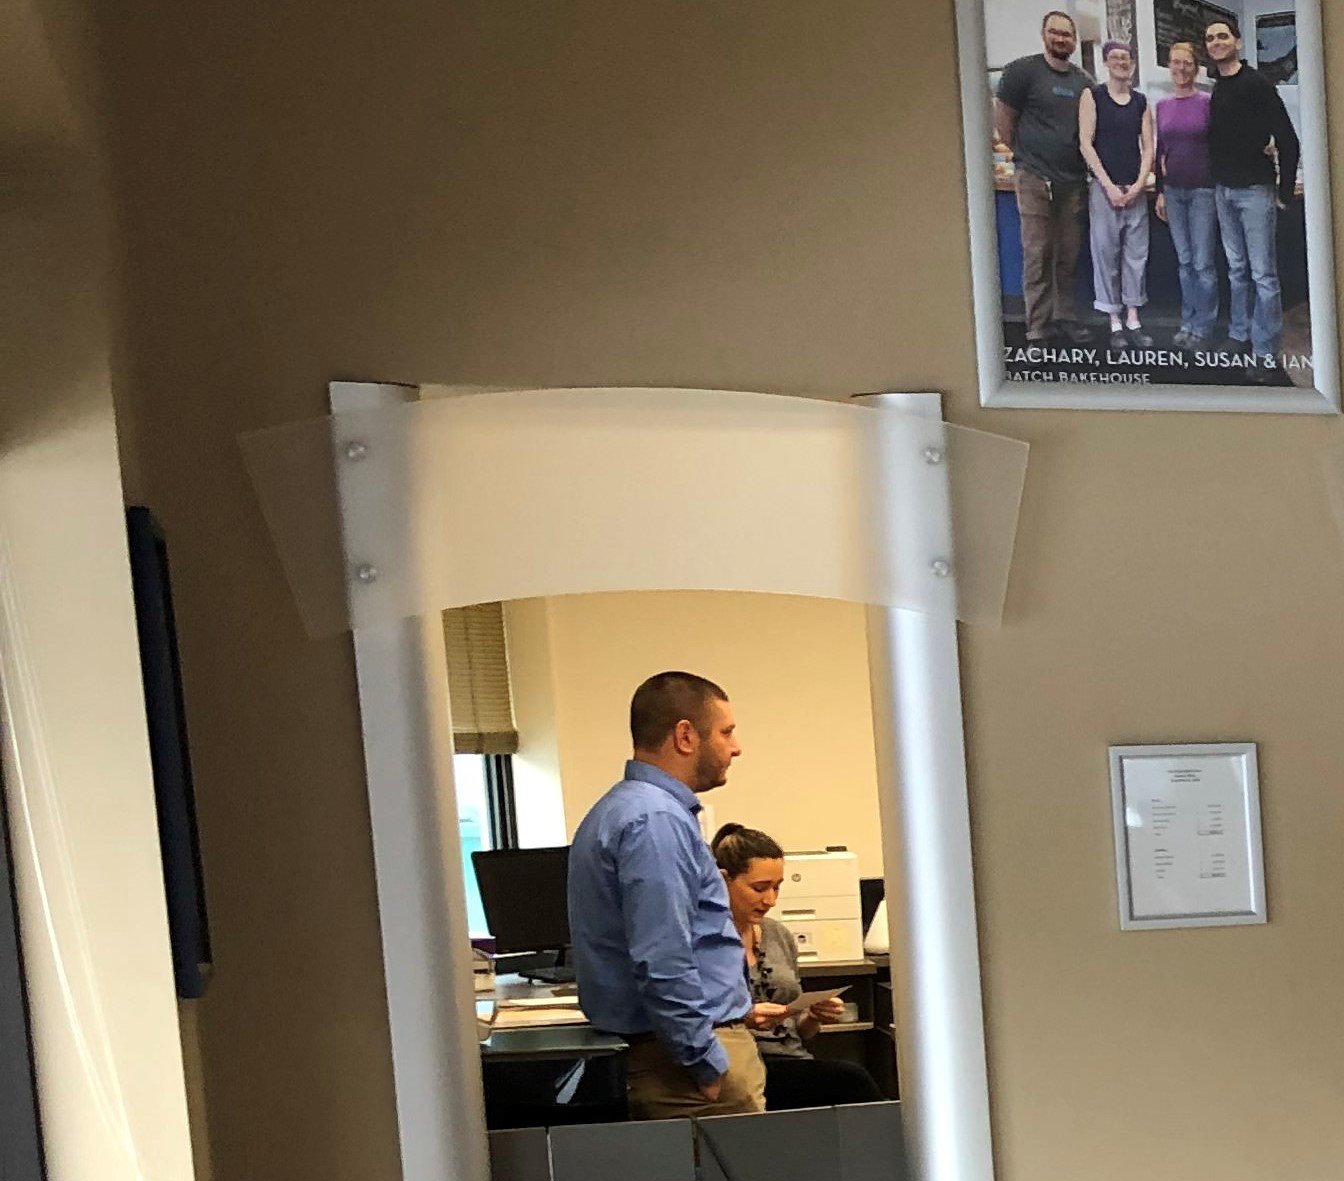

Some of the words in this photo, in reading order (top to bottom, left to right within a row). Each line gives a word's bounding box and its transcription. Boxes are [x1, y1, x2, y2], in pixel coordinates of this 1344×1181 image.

[1003, 346, 1100, 367] ZACHARY,
[1106, 349, 1188, 369] LAUREN,
[1194, 351, 1257, 368] SUSAN
[1263, 353, 1277, 369] &
[1282, 354, 1314, 371] IAN
[1058, 371, 1150, 384] BAKEHOUSE
